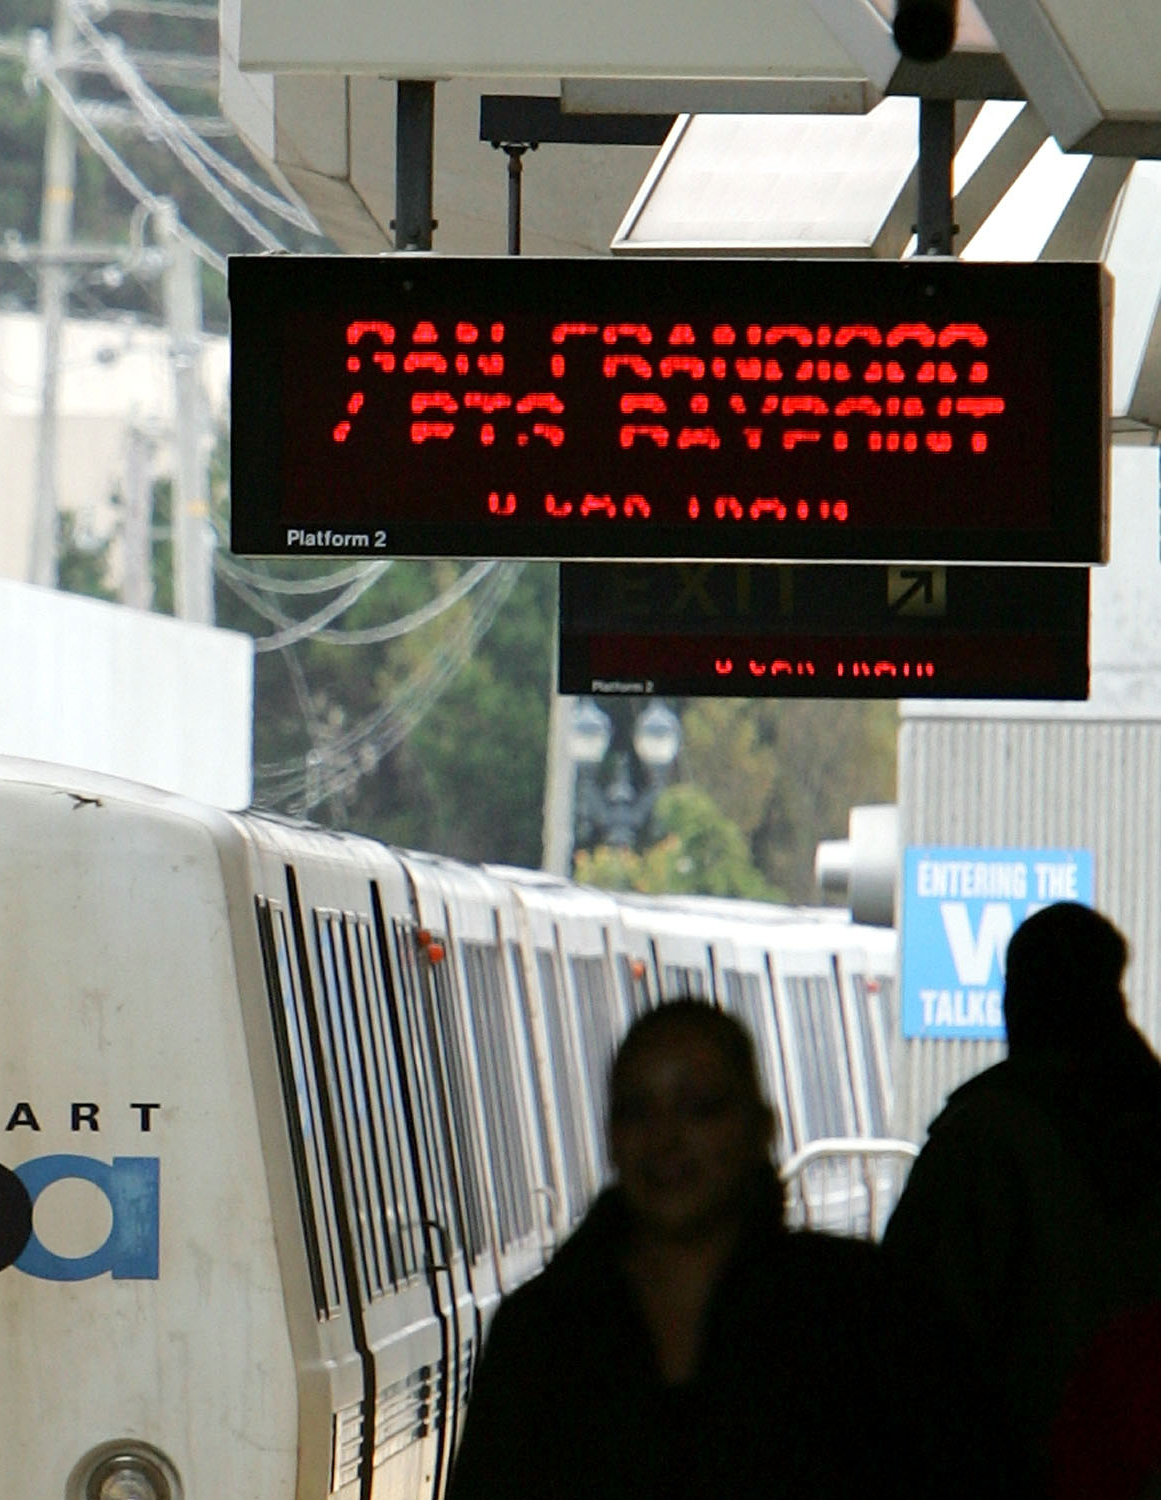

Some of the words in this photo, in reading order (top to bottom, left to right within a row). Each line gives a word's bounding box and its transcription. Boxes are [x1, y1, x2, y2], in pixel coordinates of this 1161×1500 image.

[286, 528, 370, 547] Platform
[374, 530, 388, 548] 2
[917, 860, 1028, 899] ENTERING
[1034, 862, 1078, 899] THE
